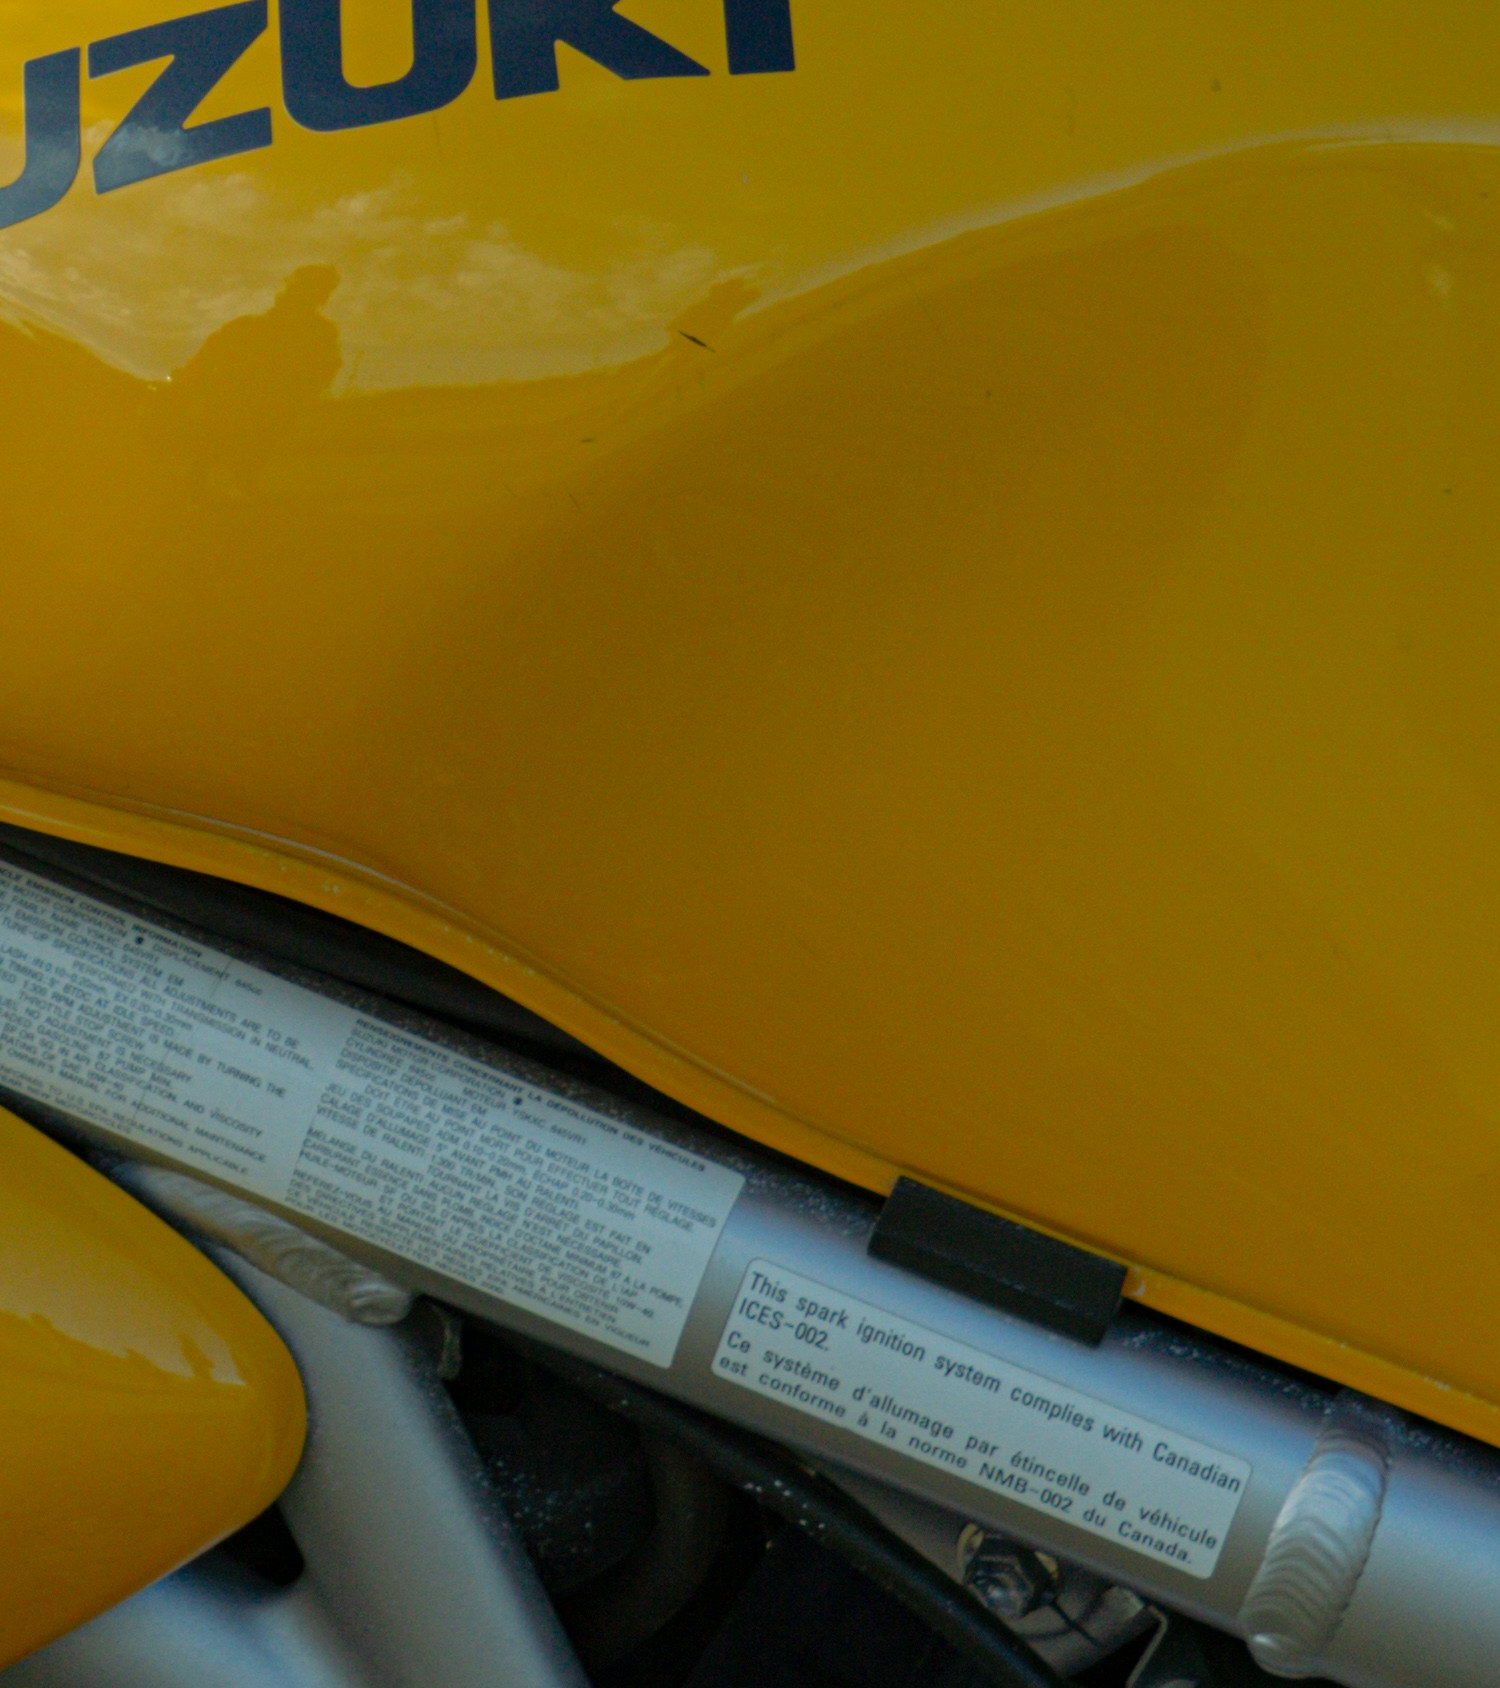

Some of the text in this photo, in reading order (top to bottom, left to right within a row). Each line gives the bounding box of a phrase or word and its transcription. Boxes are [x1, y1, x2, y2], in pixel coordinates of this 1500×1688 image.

[736, 1297, 834, 1352] ICES-002.
[746, 1271, 1243, 1495] This spark ignition system complies with Canadian
[717, 1355, 1196, 1566] est conforme à la norme NMB-002 du Canada.
[724, 1331, 1220, 1551] Ce système d'allumage par étincelle de véhicule
